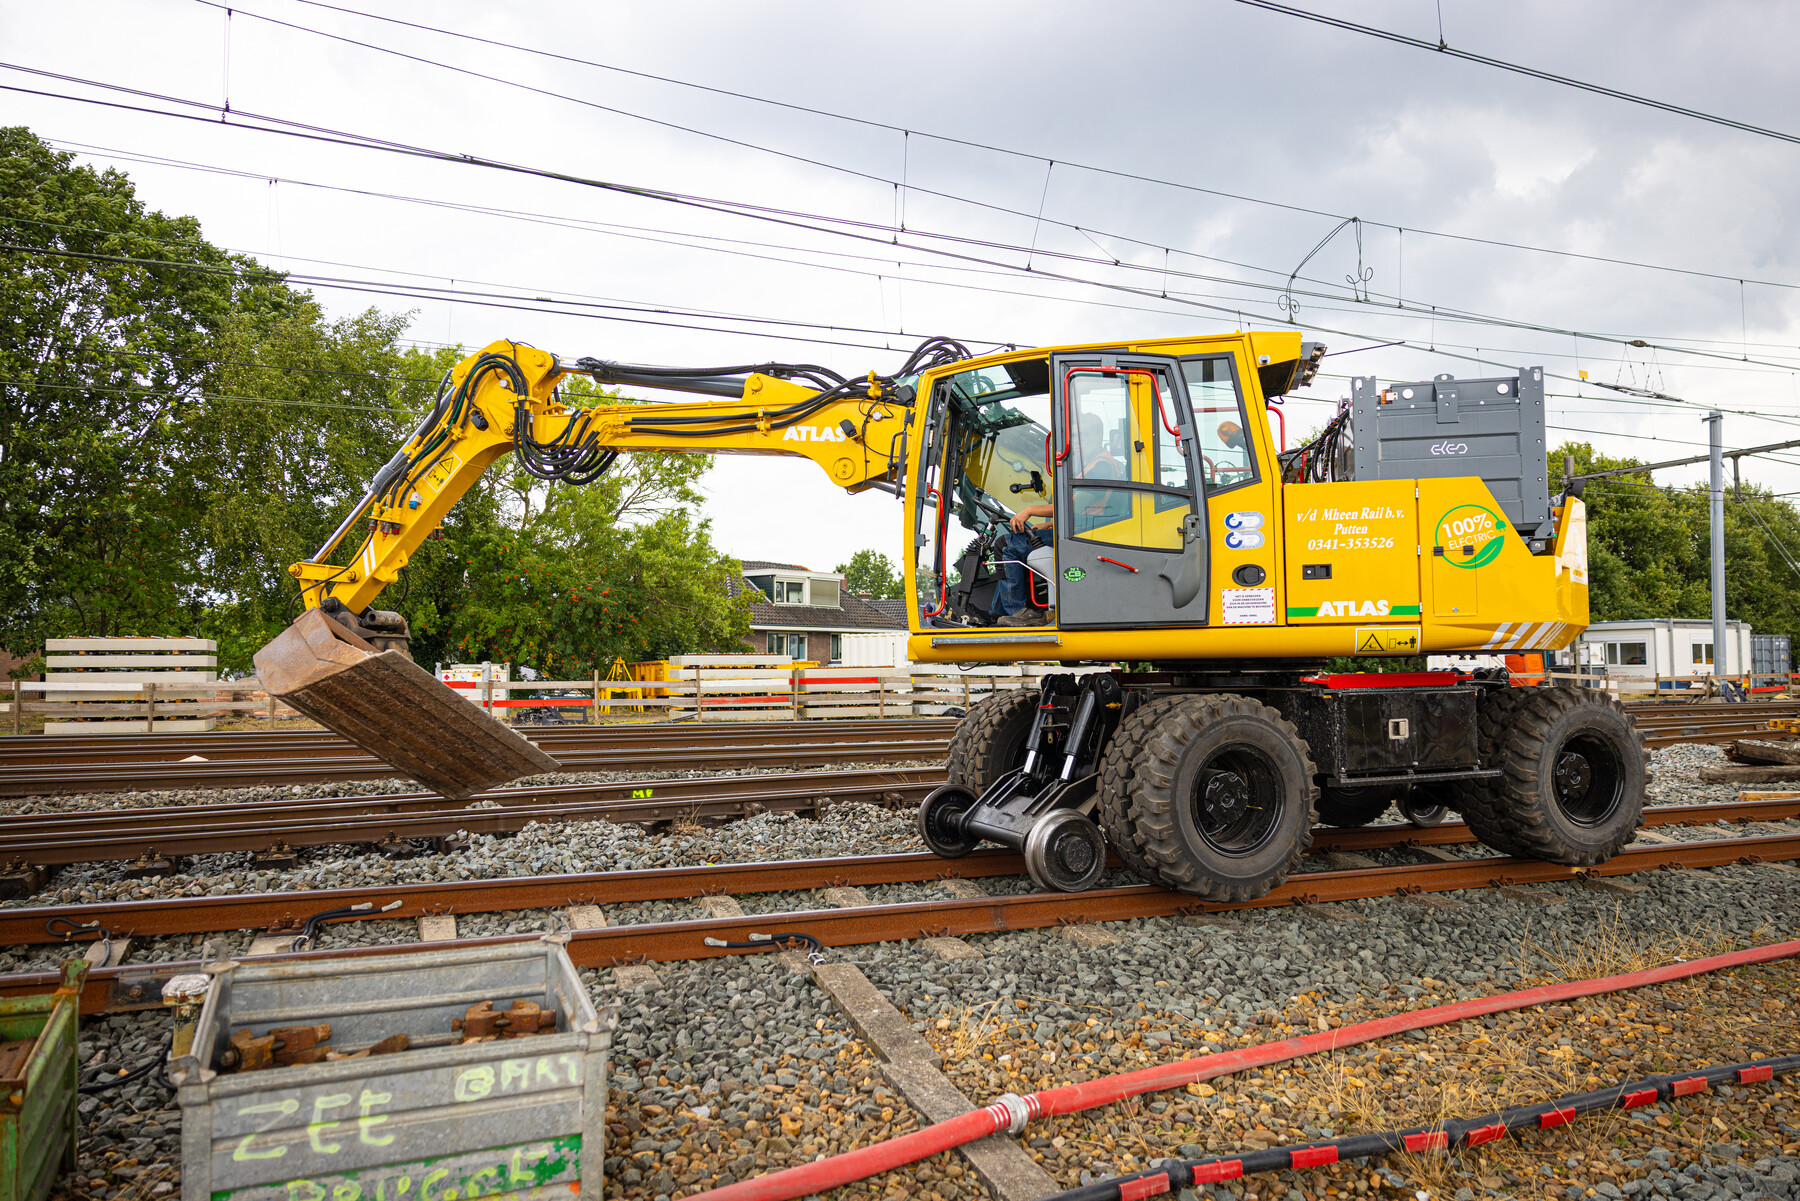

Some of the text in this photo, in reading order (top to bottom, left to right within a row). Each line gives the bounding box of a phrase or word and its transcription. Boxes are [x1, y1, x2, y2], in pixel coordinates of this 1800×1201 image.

[782, 426, 846, 442] ATLAS
[1297, 506, 1405, 522] v/d Mheen Rail b.v.
[1334, 523, 1368, 535] Putten
[1442, 512, 1492, 538] 100%
[1307, 537, 1394, 550] 0341-353526
[1448, 529, 1496, 550] ELECTRIC
[1317, 599, 1390, 617] ATLAS
